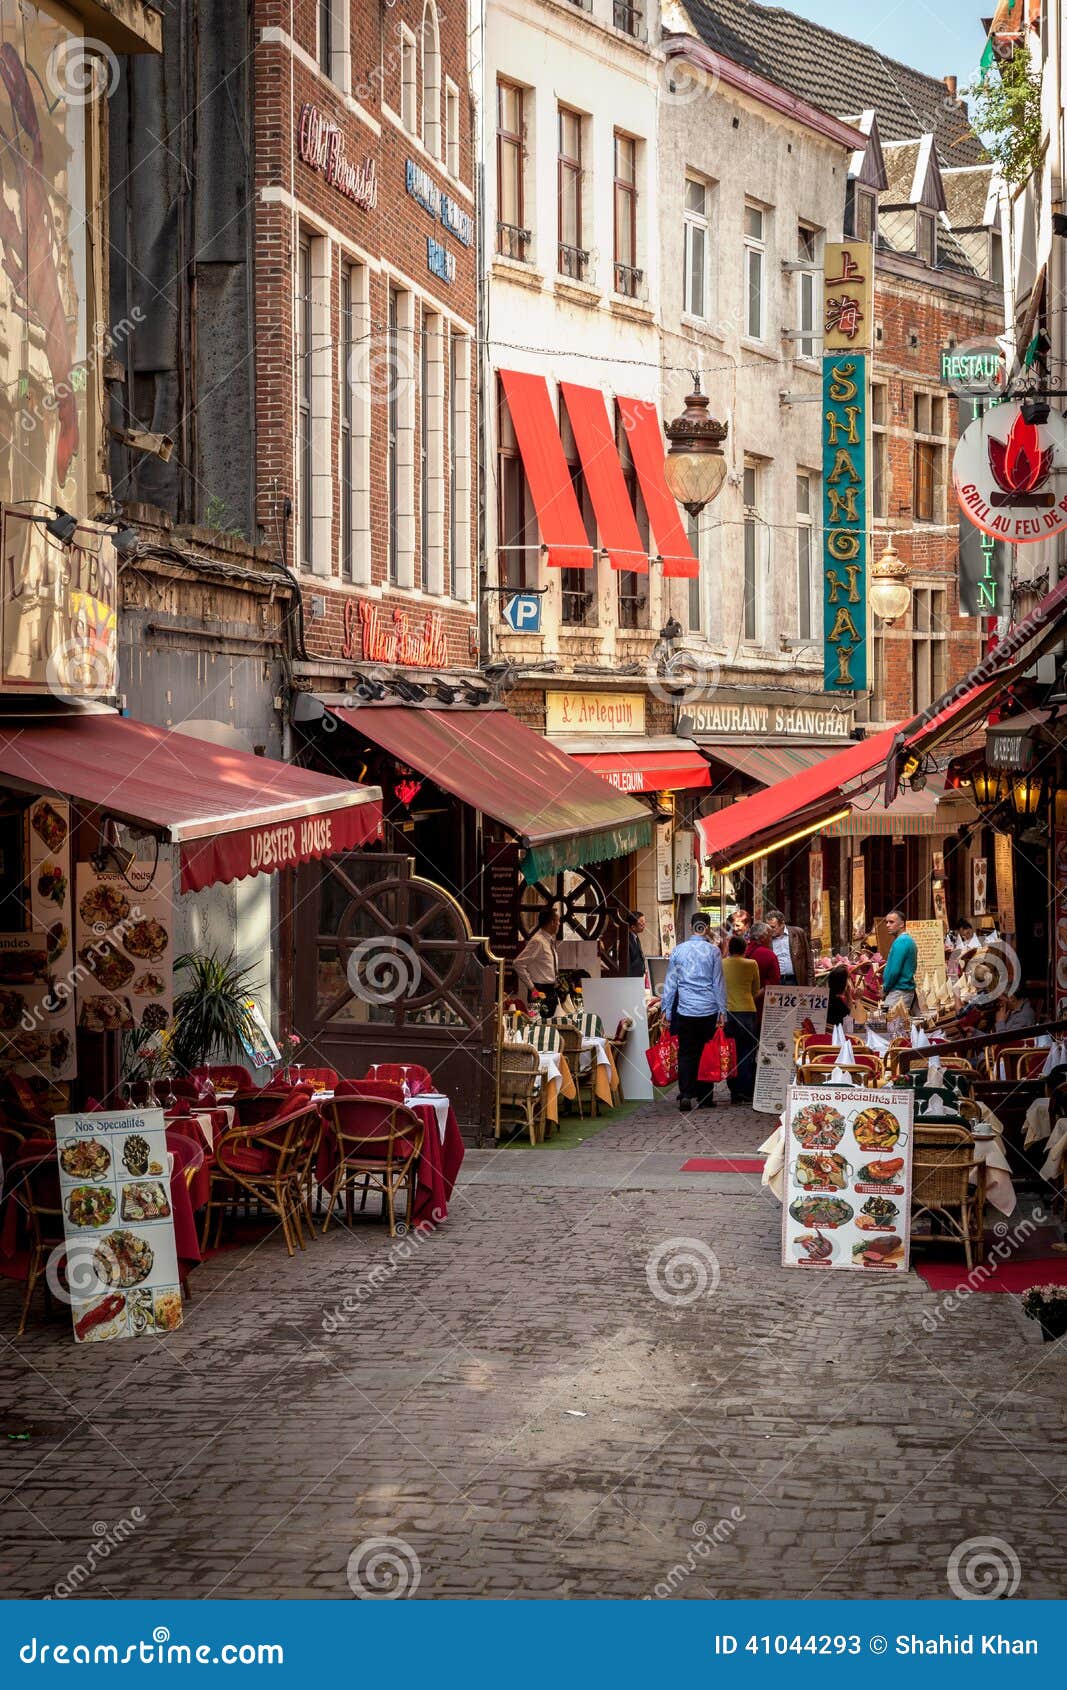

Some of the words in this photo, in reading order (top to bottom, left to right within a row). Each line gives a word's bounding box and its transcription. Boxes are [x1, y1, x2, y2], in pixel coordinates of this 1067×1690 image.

[825, 250, 864, 340] 上海
[961, 483, 988, 523] GRILL
[991, 514, 1011, 535] AU
[1015, 517, 1040, 535] FEU
[1042, 509, 1063, 528] DE
[516, 601, 538, 627] P
[562, 694, 633, 729] L'Arlequin
[250, 825, 296, 869] LOBSTER
[300, 818, 332, 855] HOUSE
[778, 995, 797, 1007] 12€
[809, 997, 828, 1009] 12€
[810, 1091, 832, 1102] Nos
[834, 1090, 890, 1105] Spécialités
[75, 1120, 94, 1132] Nos
